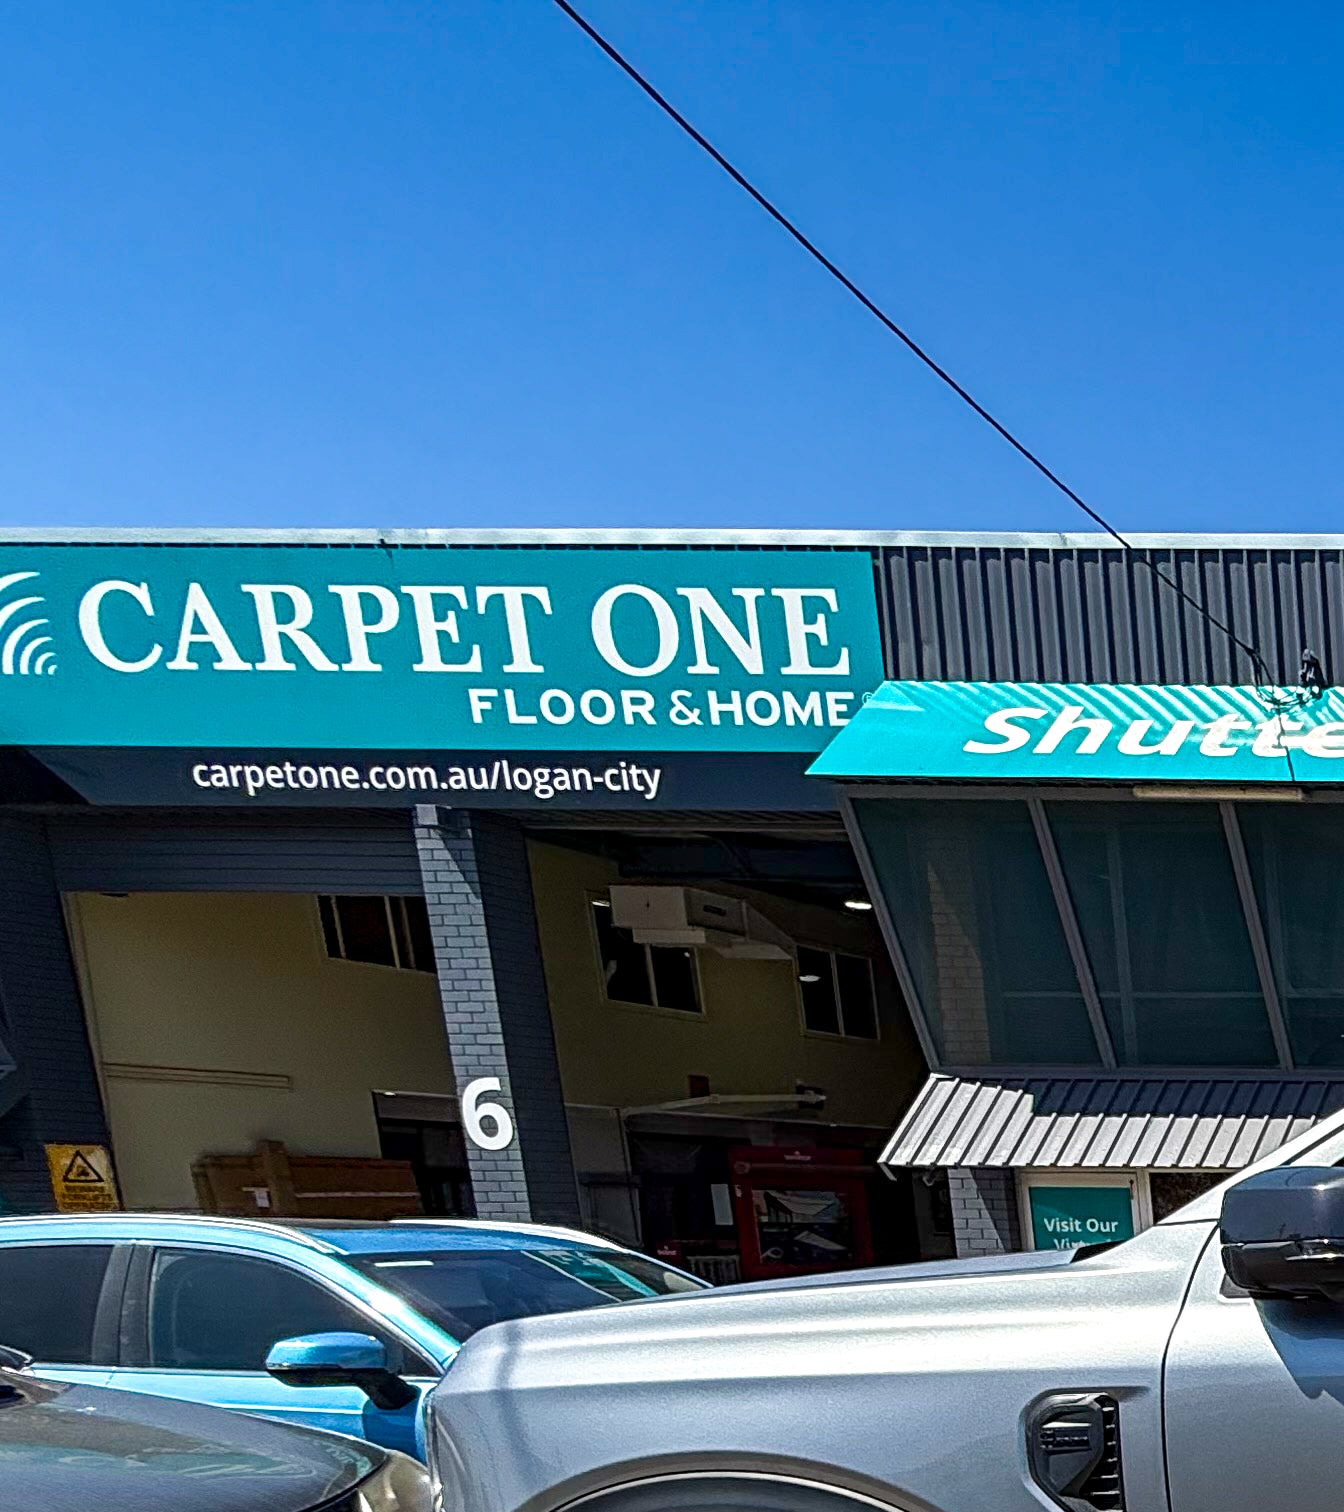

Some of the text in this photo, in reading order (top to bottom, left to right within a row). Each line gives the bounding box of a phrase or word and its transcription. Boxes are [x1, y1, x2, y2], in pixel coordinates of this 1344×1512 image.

[79, 579, 852, 677] CARPET ONE
[467, 688, 657, 727] FLOOR
[192, 760, 662, 800] carpetone.com.au/logan-city
[460, 1076, 514, 1151] 6
[1044, 1217, 1119, 1233] Visit Our
